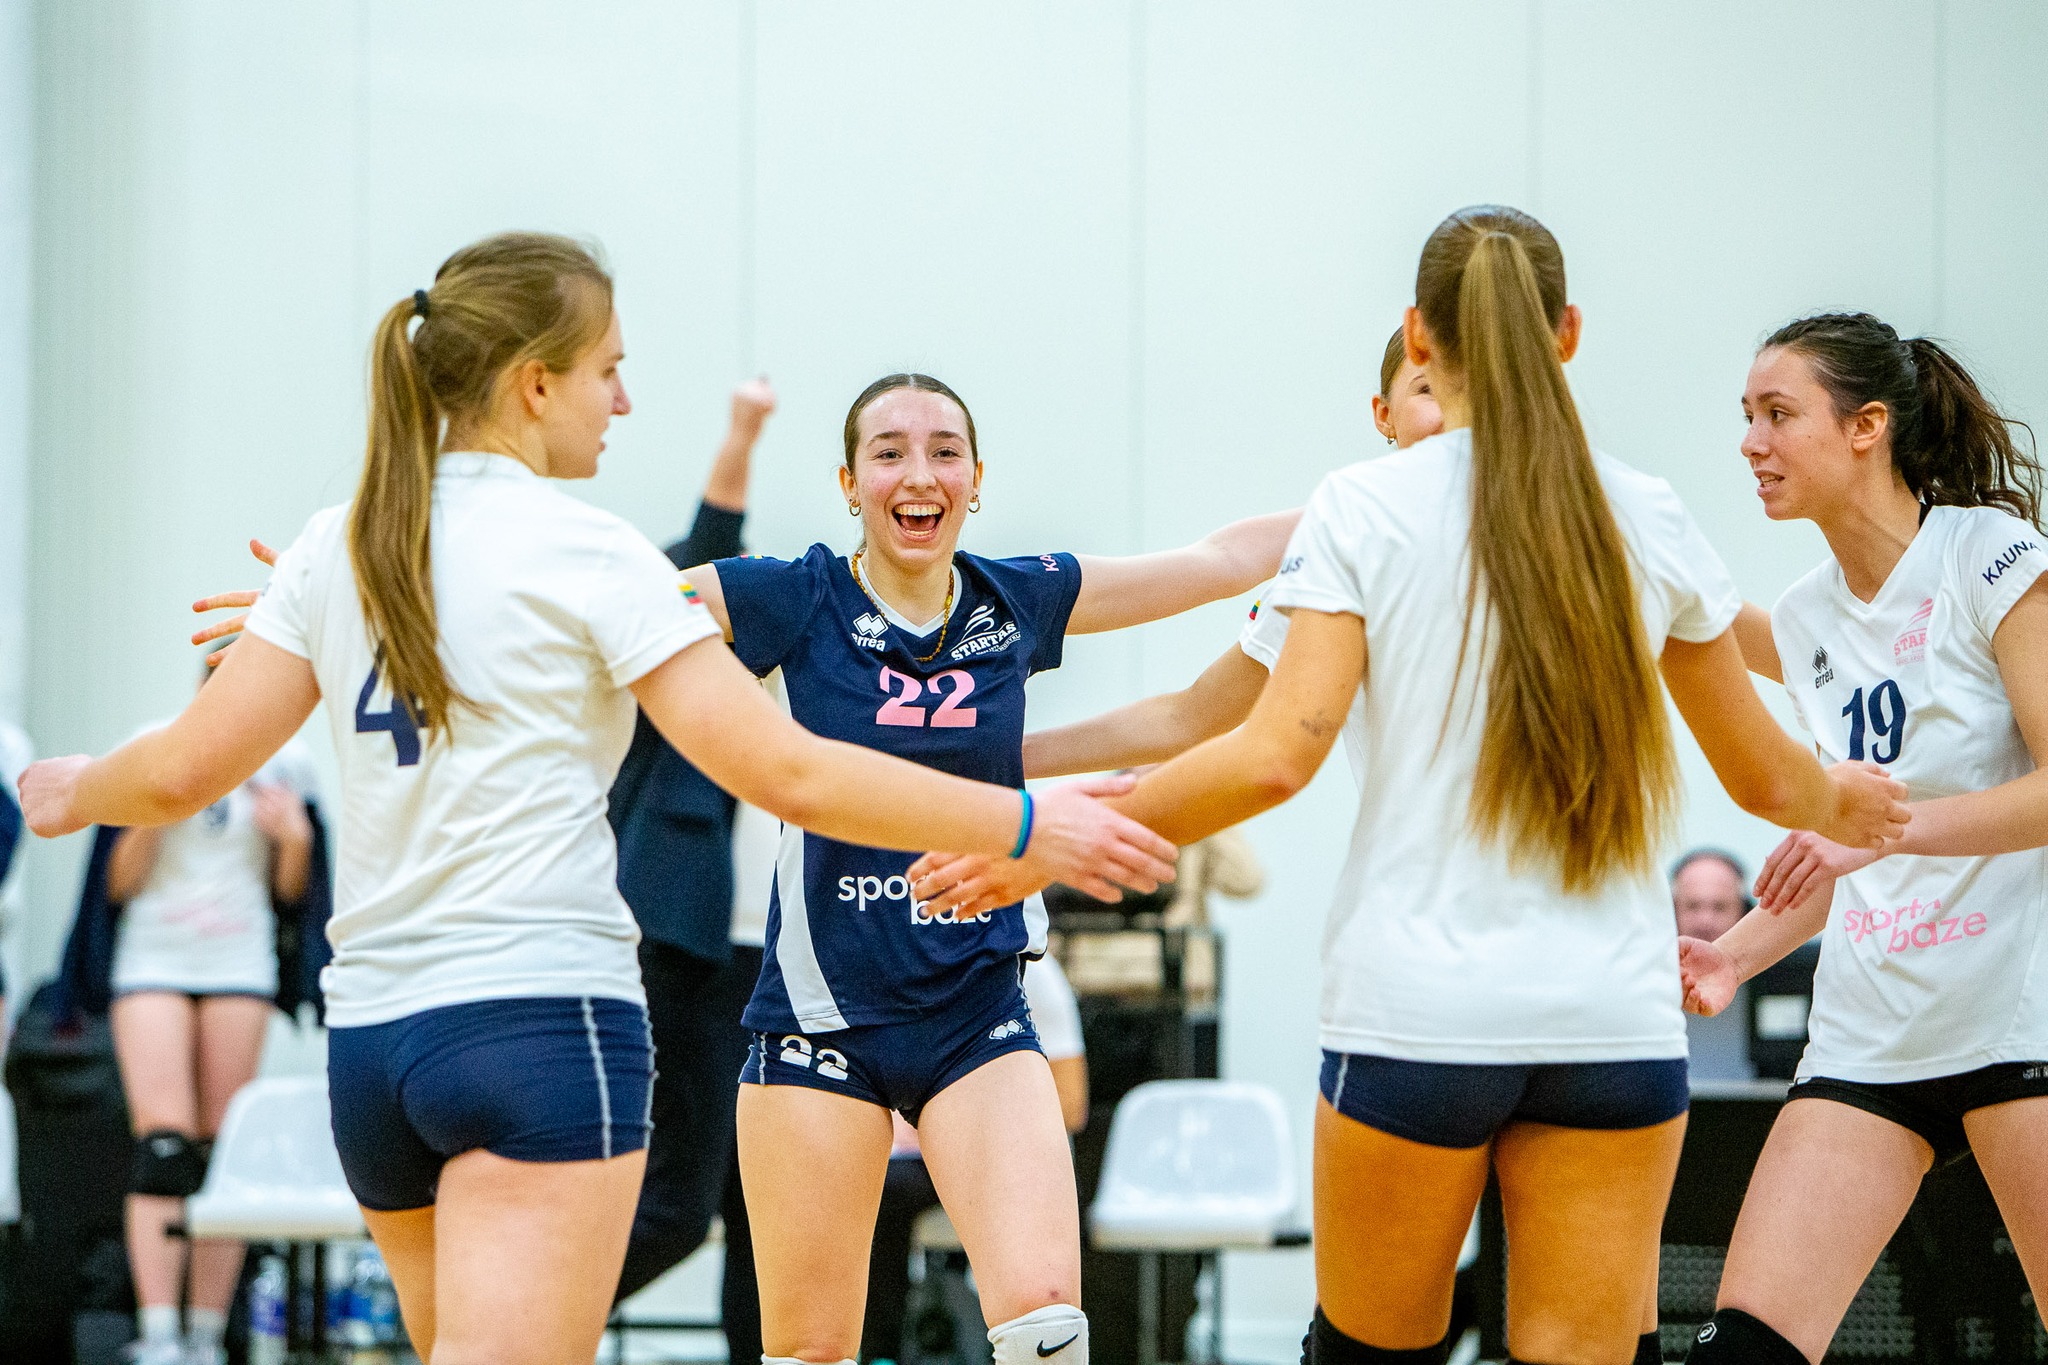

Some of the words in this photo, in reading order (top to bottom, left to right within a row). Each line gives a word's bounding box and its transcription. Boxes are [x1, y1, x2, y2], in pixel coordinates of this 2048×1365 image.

[951, 623, 1017, 660] STARTAS
[355, 640, 429, 766] 4
[876, 666, 977, 728] 22
[1815, 668, 1834, 689] errea
[1841, 678, 1906, 764] 19
[780, 1034, 849, 1081] 22
